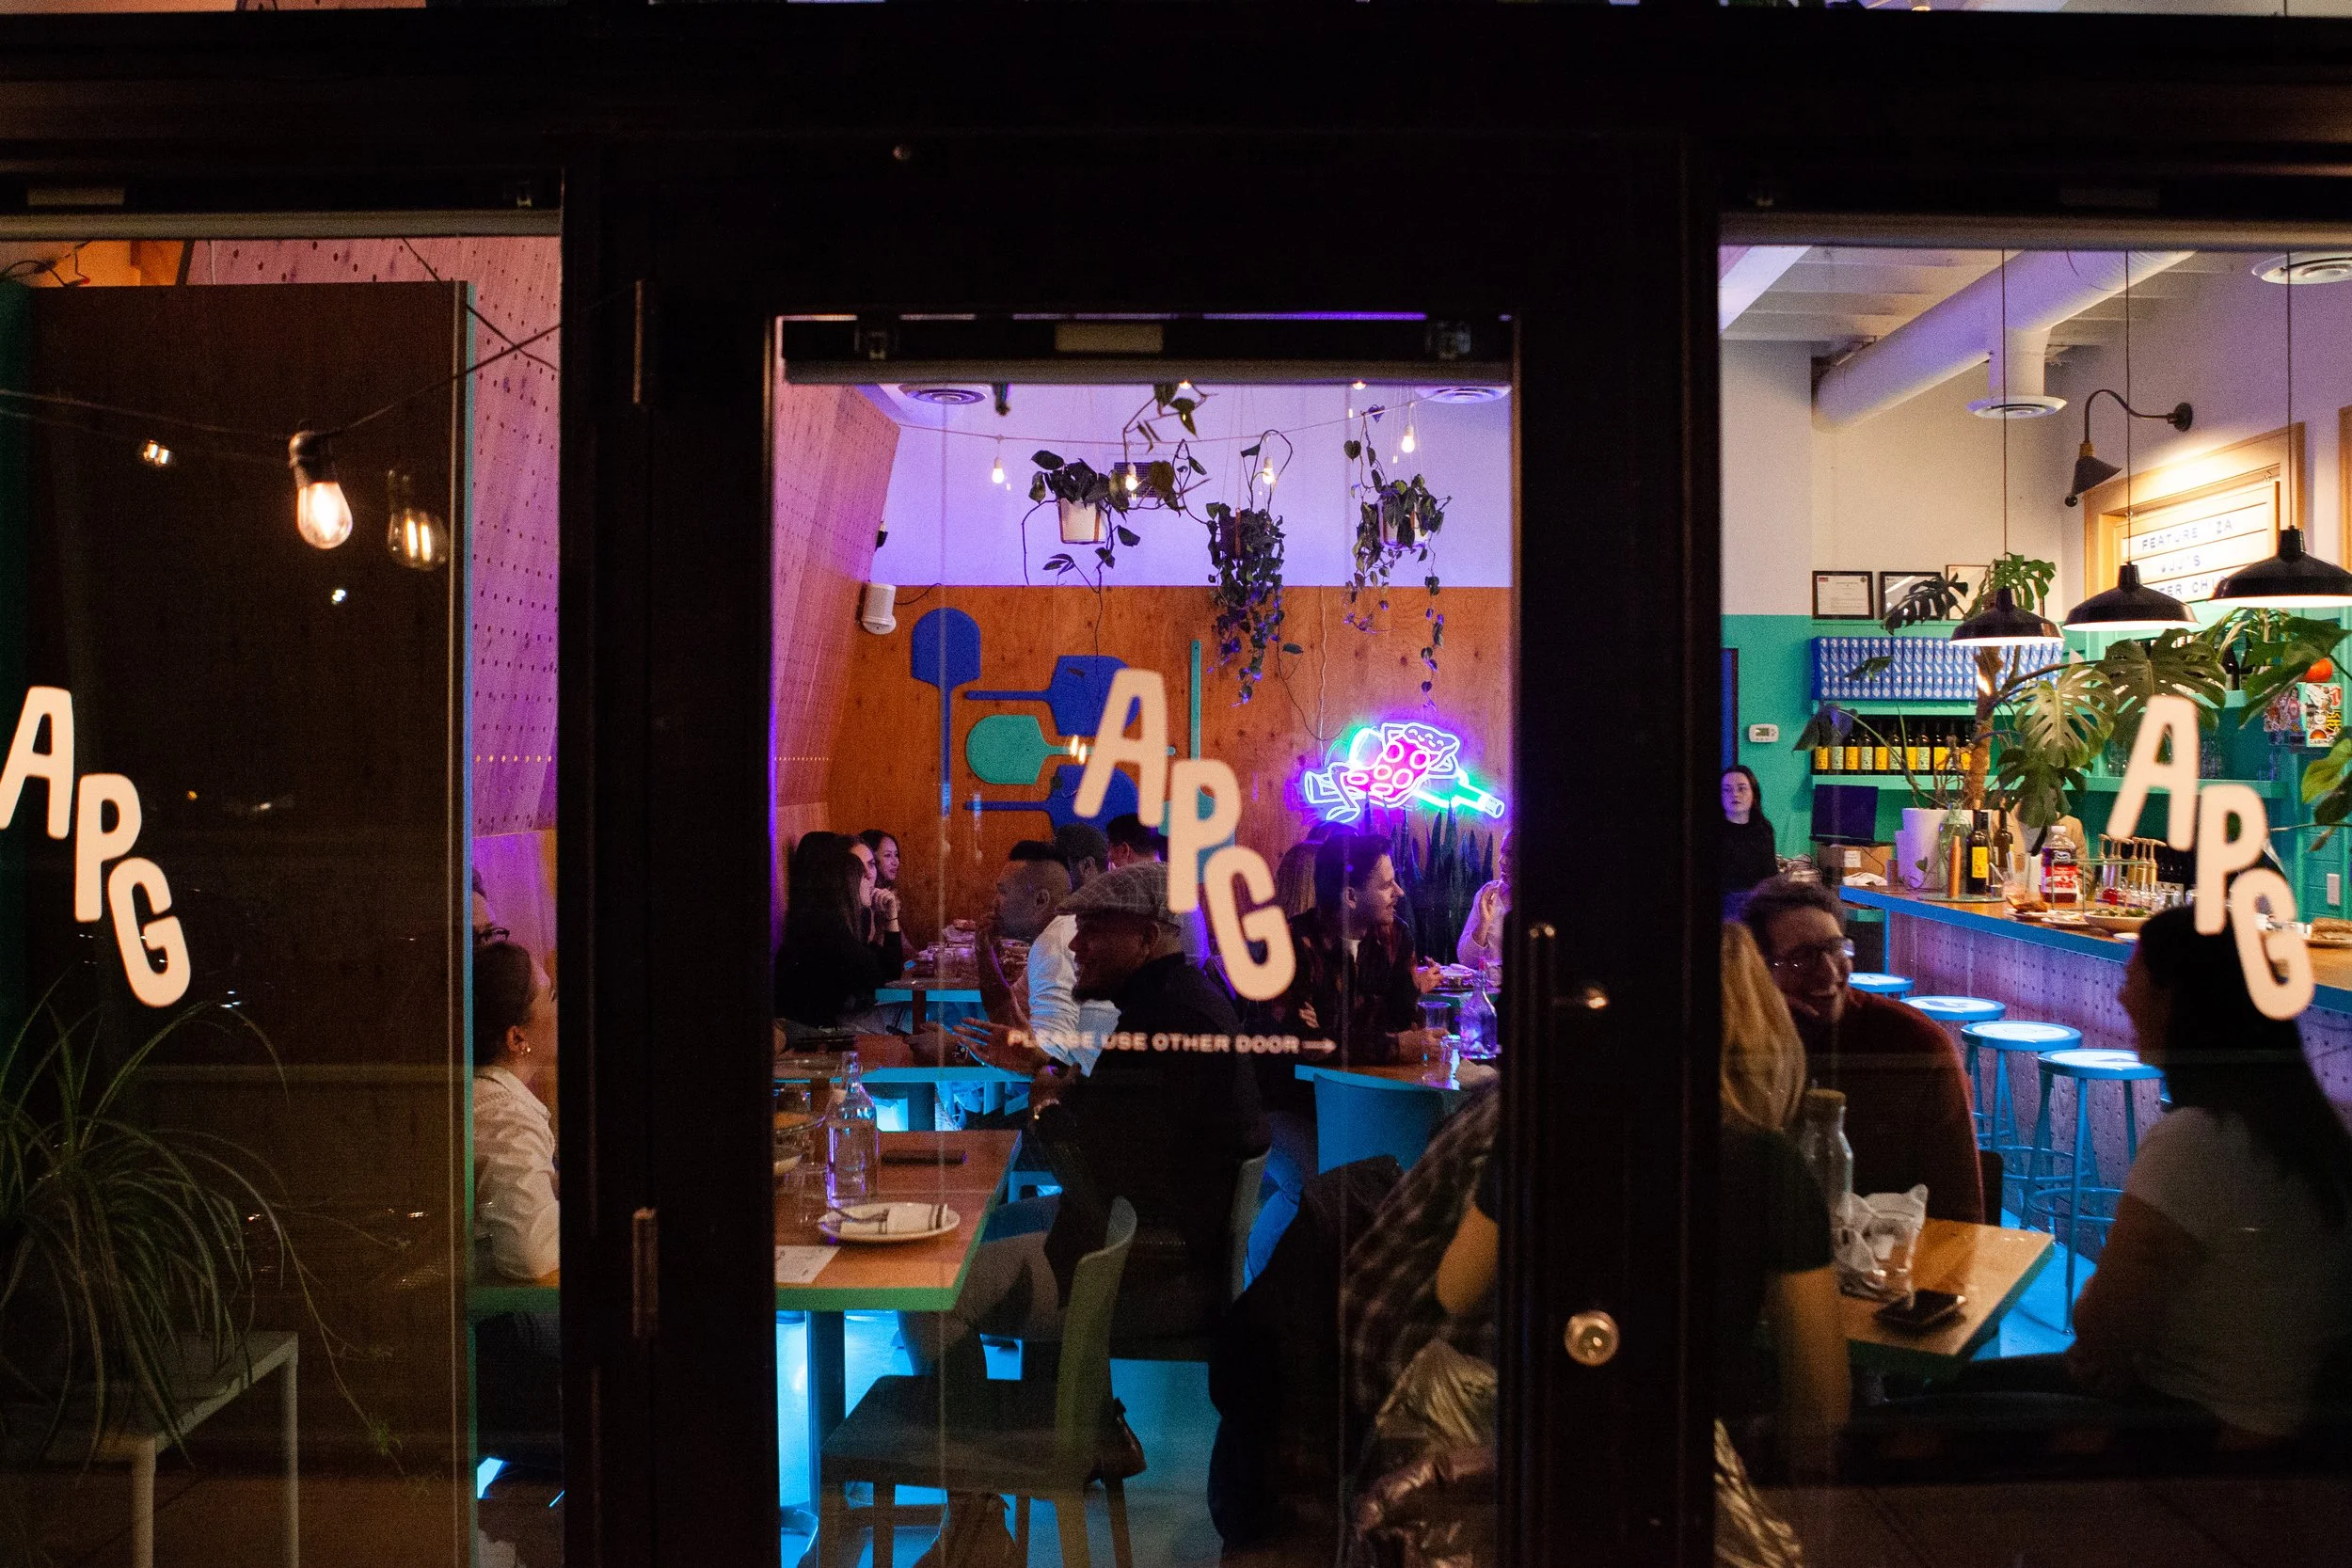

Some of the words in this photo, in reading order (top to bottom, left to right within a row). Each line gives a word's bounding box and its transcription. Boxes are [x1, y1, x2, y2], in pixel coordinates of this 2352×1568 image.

[2142, 527, 2199, 551] FEATURE
[0, 686, 191, 1007] APG
[1073, 668, 1296, 1002] APG
[2106, 694, 2315, 1021] APG
[1101, 1032, 1148, 1052] USE
[1152, 1032, 1231, 1053] OTHER
[1234, 1034, 1299, 1054] DOOR
